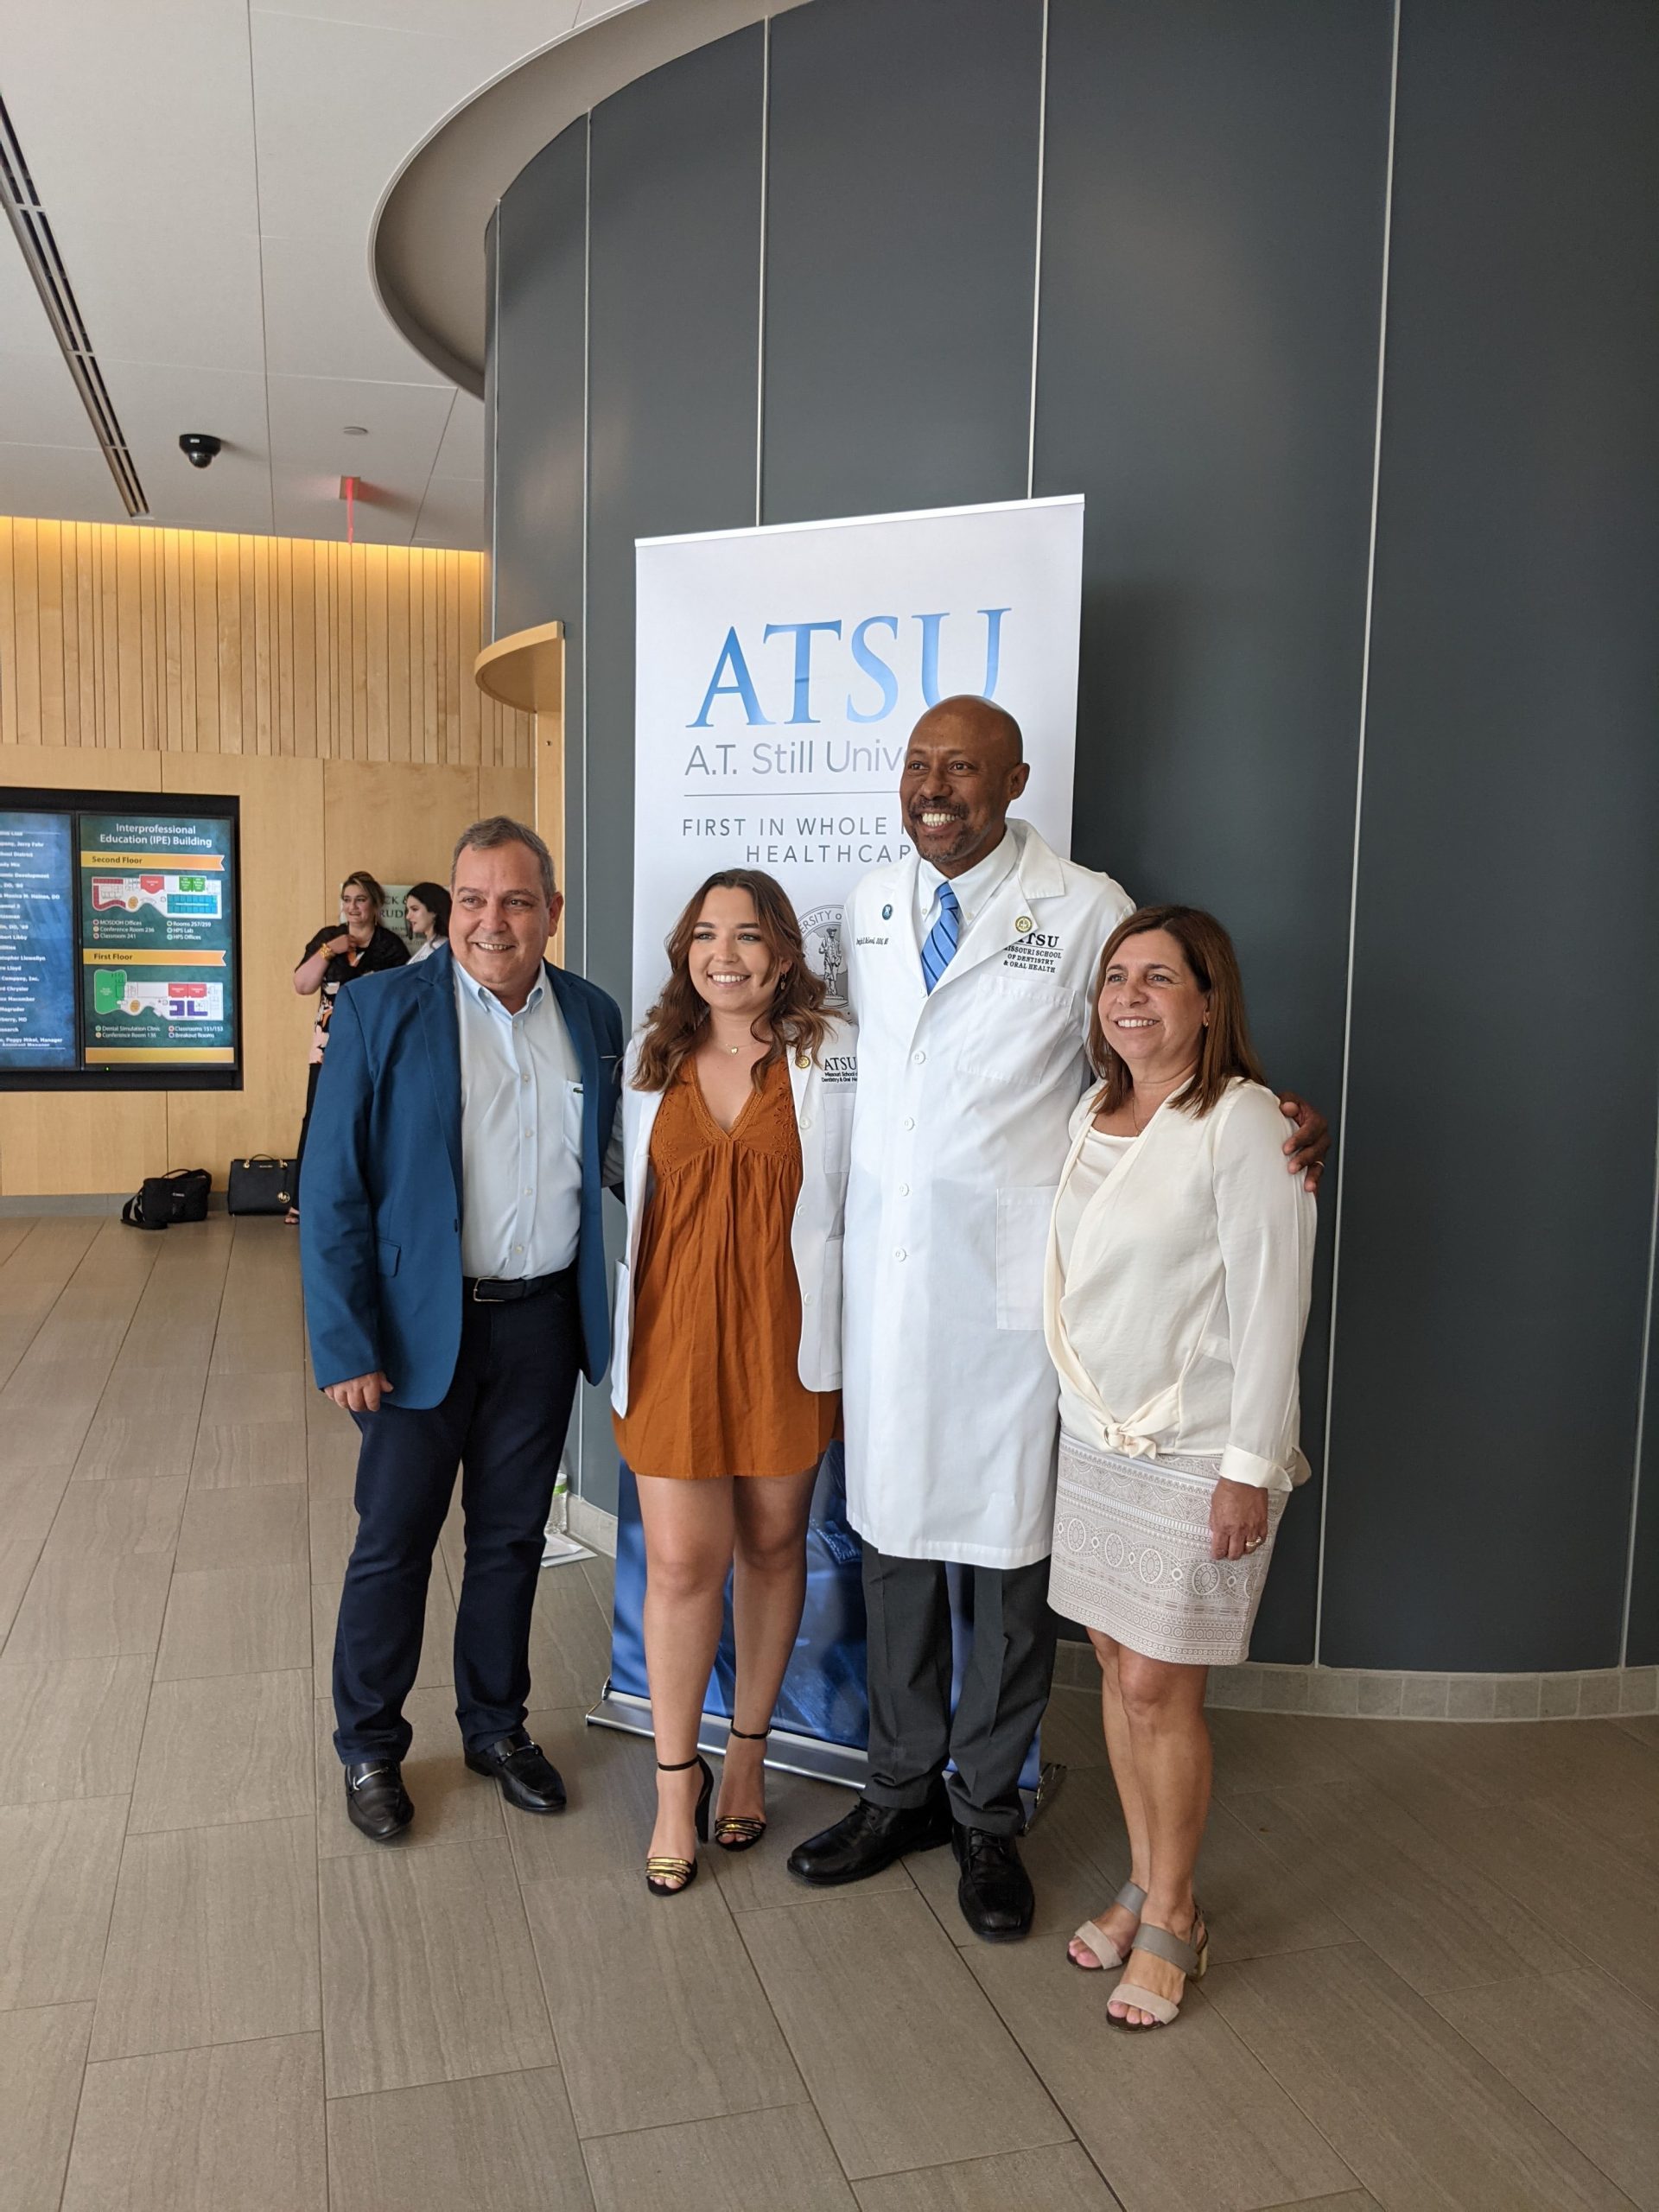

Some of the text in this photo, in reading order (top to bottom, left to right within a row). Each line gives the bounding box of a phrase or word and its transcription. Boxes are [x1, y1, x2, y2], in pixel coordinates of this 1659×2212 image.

[685, 607, 1012, 728] ATSU
[684, 739, 906, 776] A.T. Still Univ
[116, 823, 196, 835] Interprofessional
[683, 817, 746, 836] FIRST
[760, 817, 784, 836] IN
[797, 817, 887, 836] WHOLE
[99, 834, 213, 849] Education (IPE) Building
[1017, 932, 1059, 948] TSU
[1003, 944, 1062, 959] ISSOURI SCHOOL
[1017, 955, 1054, 965] DENTISTRY
[1028, 963, 1056, 973] HEALTH
[824, 1056, 857, 1071] ATSU
